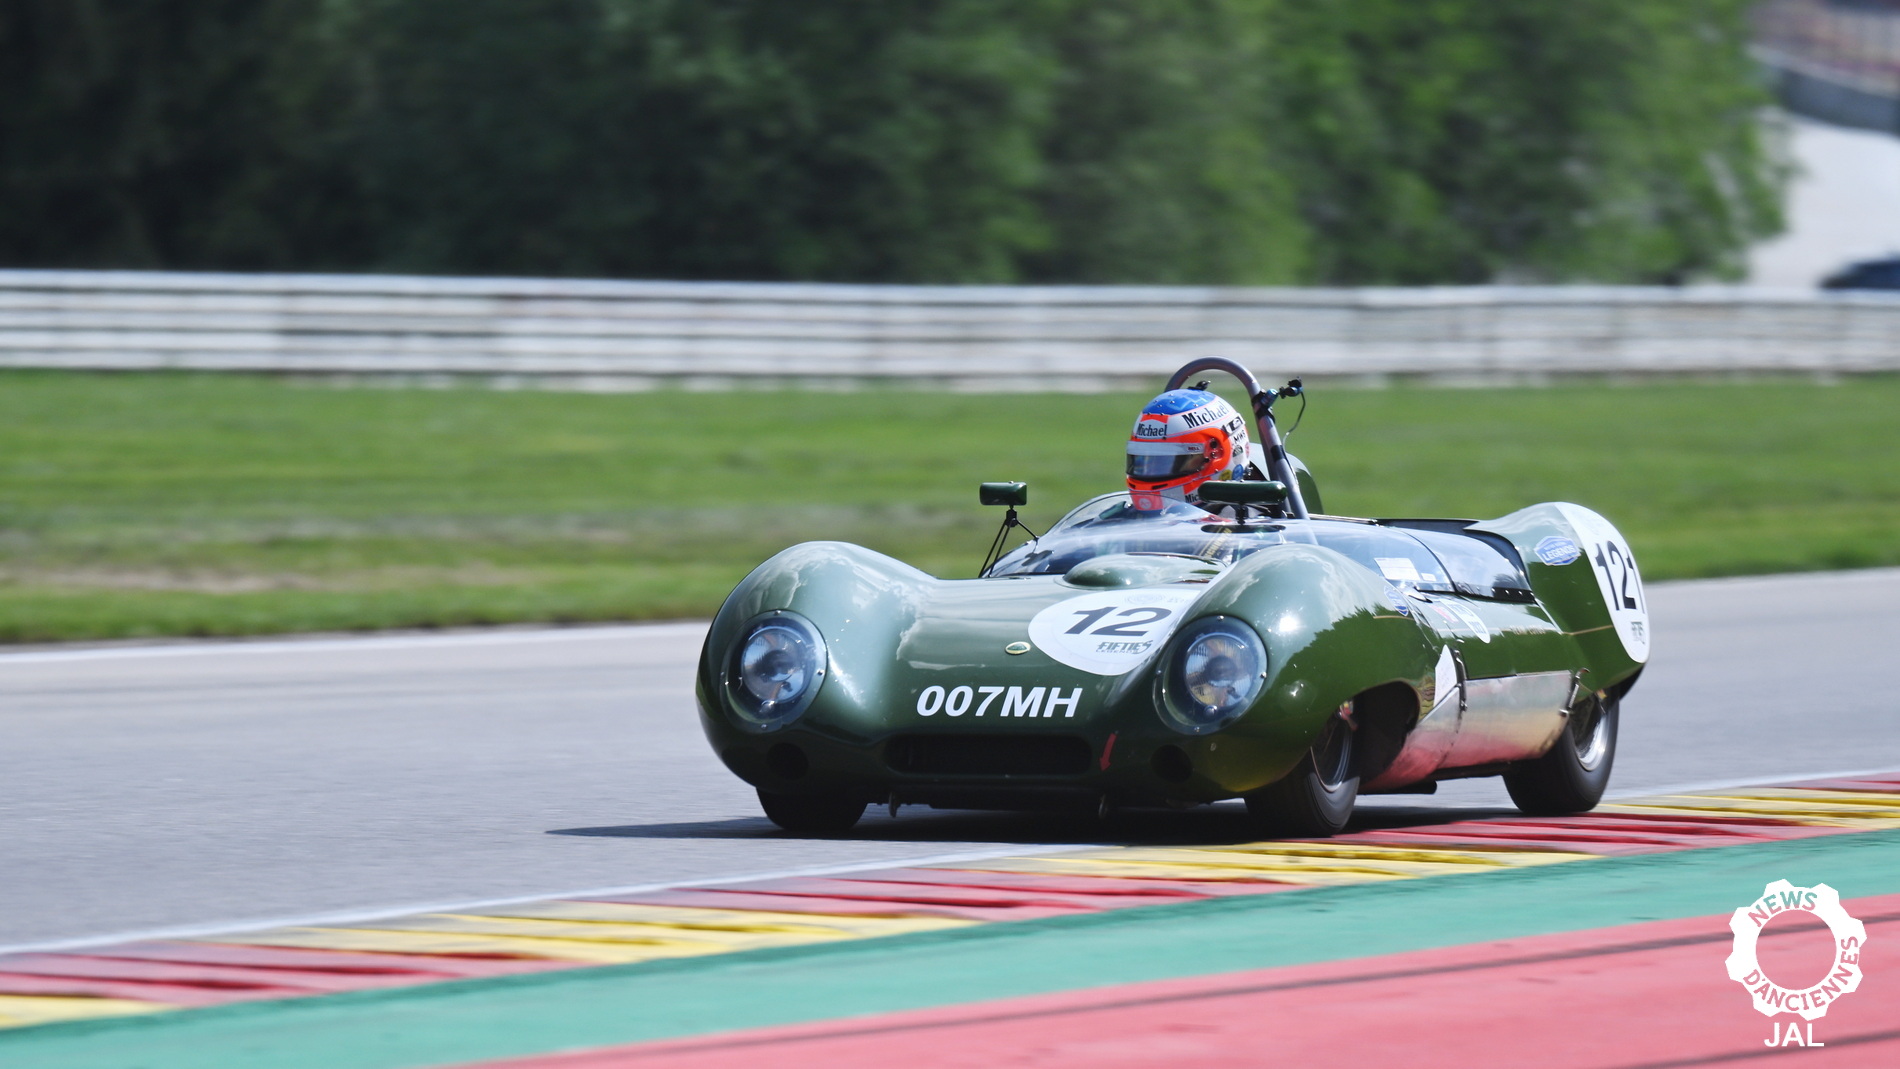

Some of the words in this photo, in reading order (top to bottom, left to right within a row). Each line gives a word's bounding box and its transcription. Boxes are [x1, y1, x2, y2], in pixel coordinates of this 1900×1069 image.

[1182, 401, 1230, 428] Michael
[1137, 423, 1168, 437] Michael
[1542, 545, 1576, 561] LEGENDS
[1064, 606, 1172, 637] 12
[916, 686, 1083, 718] 007MH
